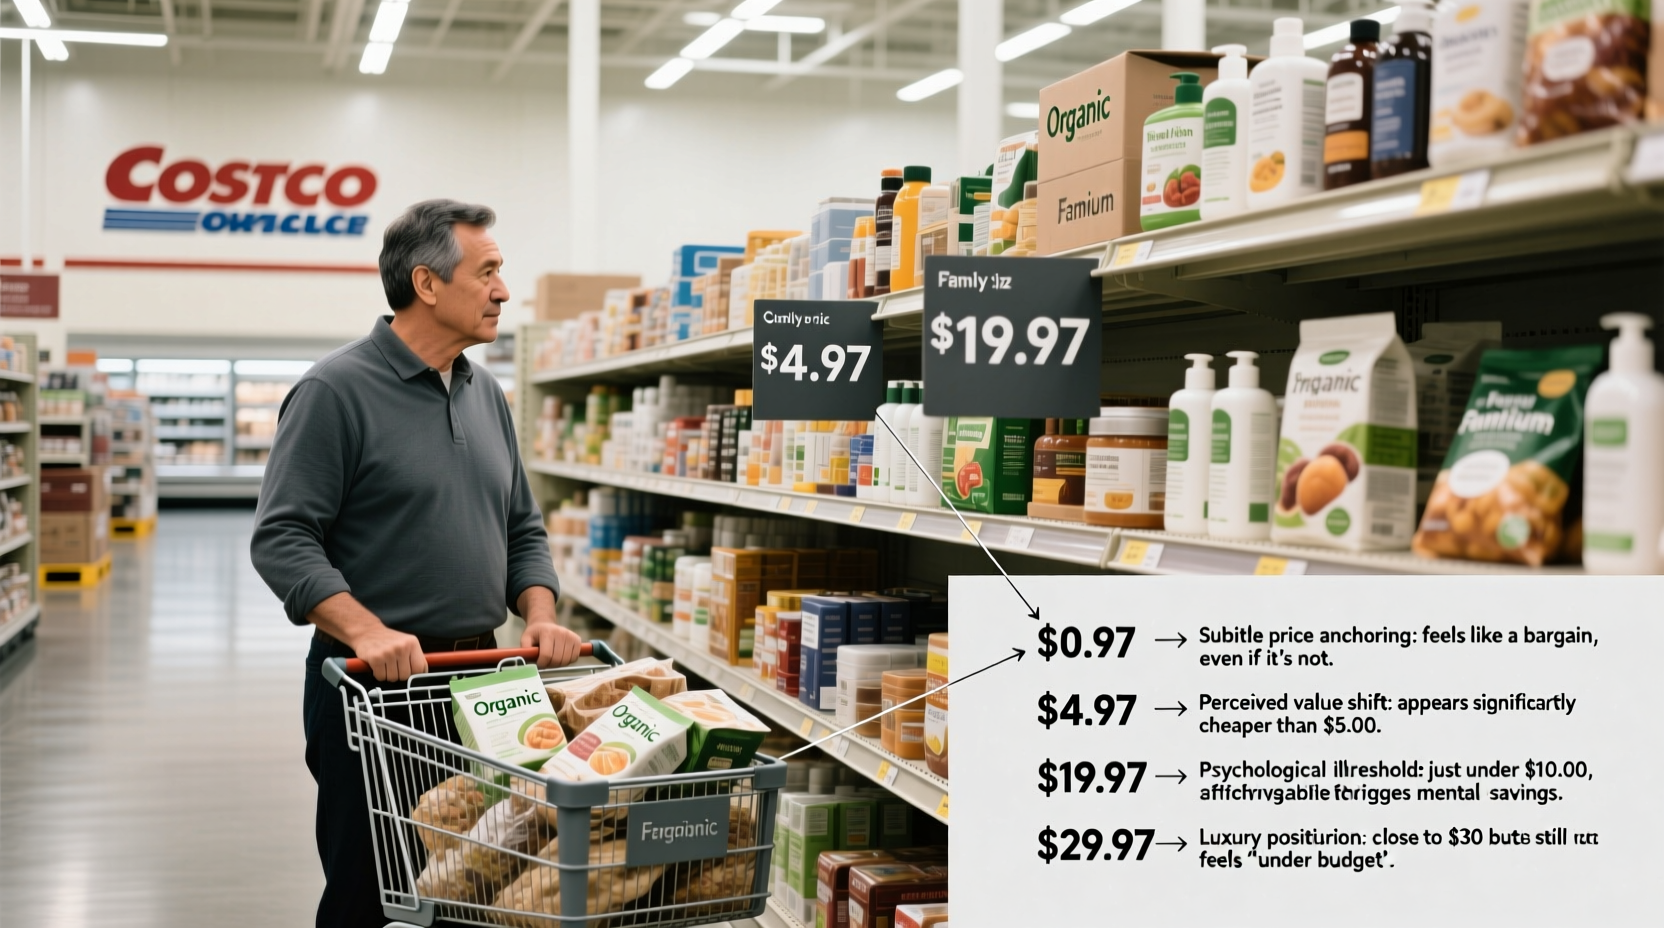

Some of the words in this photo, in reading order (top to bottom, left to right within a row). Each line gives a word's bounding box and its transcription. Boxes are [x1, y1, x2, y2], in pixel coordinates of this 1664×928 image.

[1047, 88, 1111, 142] Organic
[105, 146, 377, 207] COSTCO
[1057, 190, 1114, 225] Famium
[930, 312, 1090, 365] $19.97
[760, 342, 872, 382] $4.97
[474, 689, 541, 716] Organic
